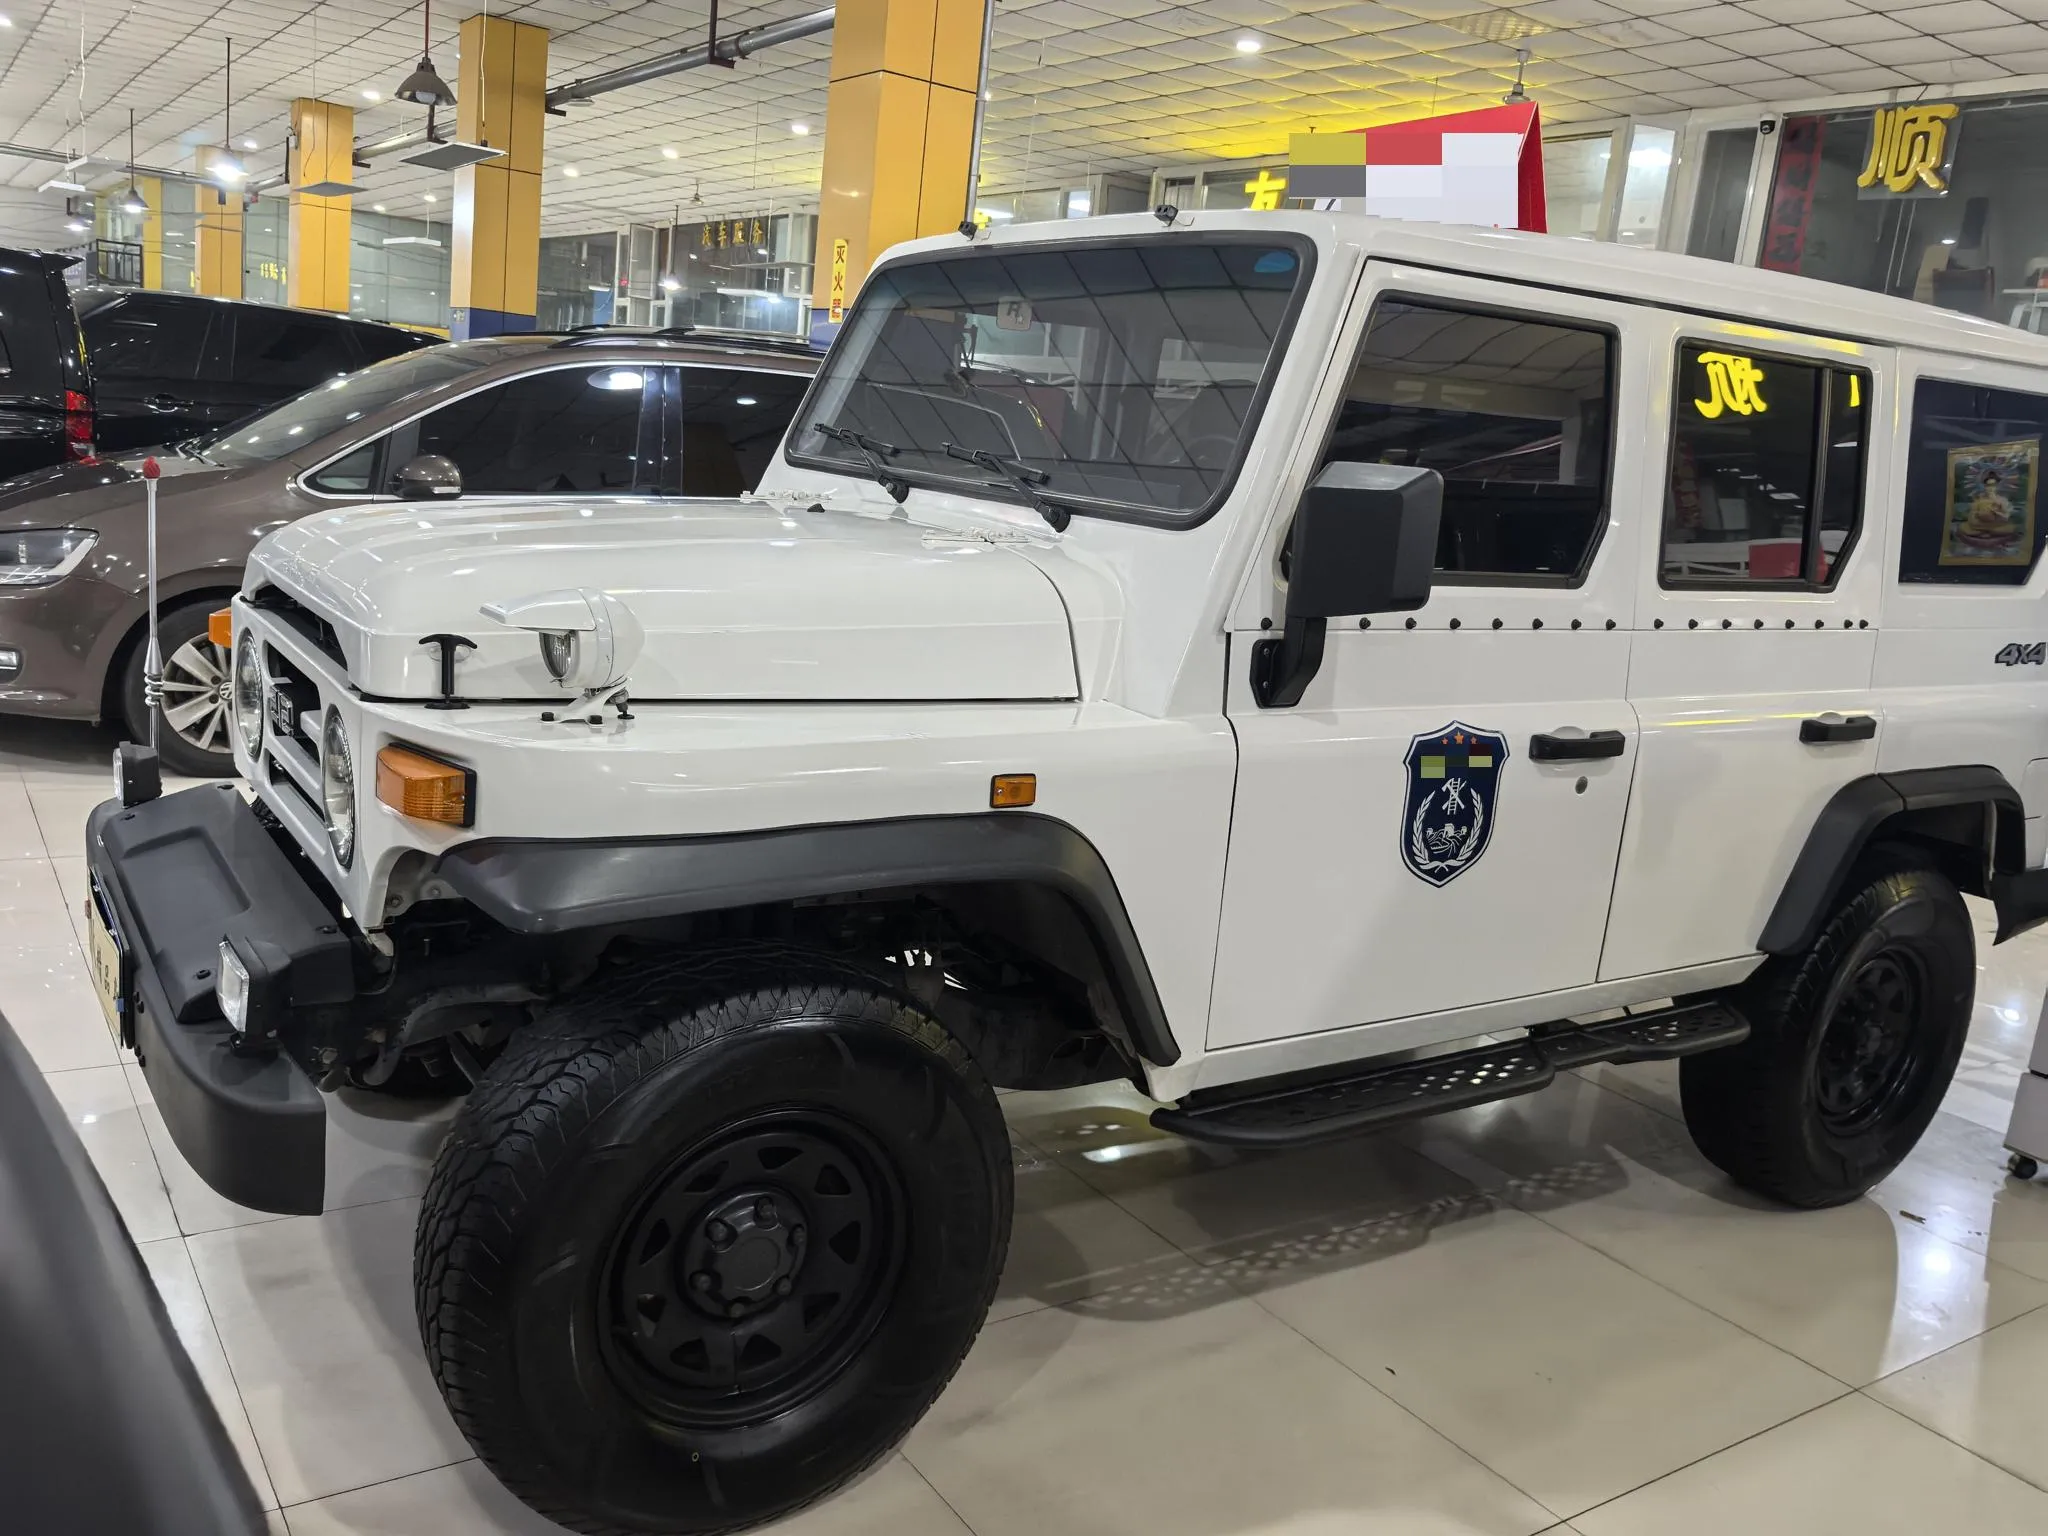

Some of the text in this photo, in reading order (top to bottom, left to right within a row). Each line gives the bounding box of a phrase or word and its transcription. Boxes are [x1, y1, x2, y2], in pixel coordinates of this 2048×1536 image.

[1857, 104, 1960, 193] 顺
[702, 219, 764, 249] 汽车服务
[831, 245, 846, 318] 灭火器
